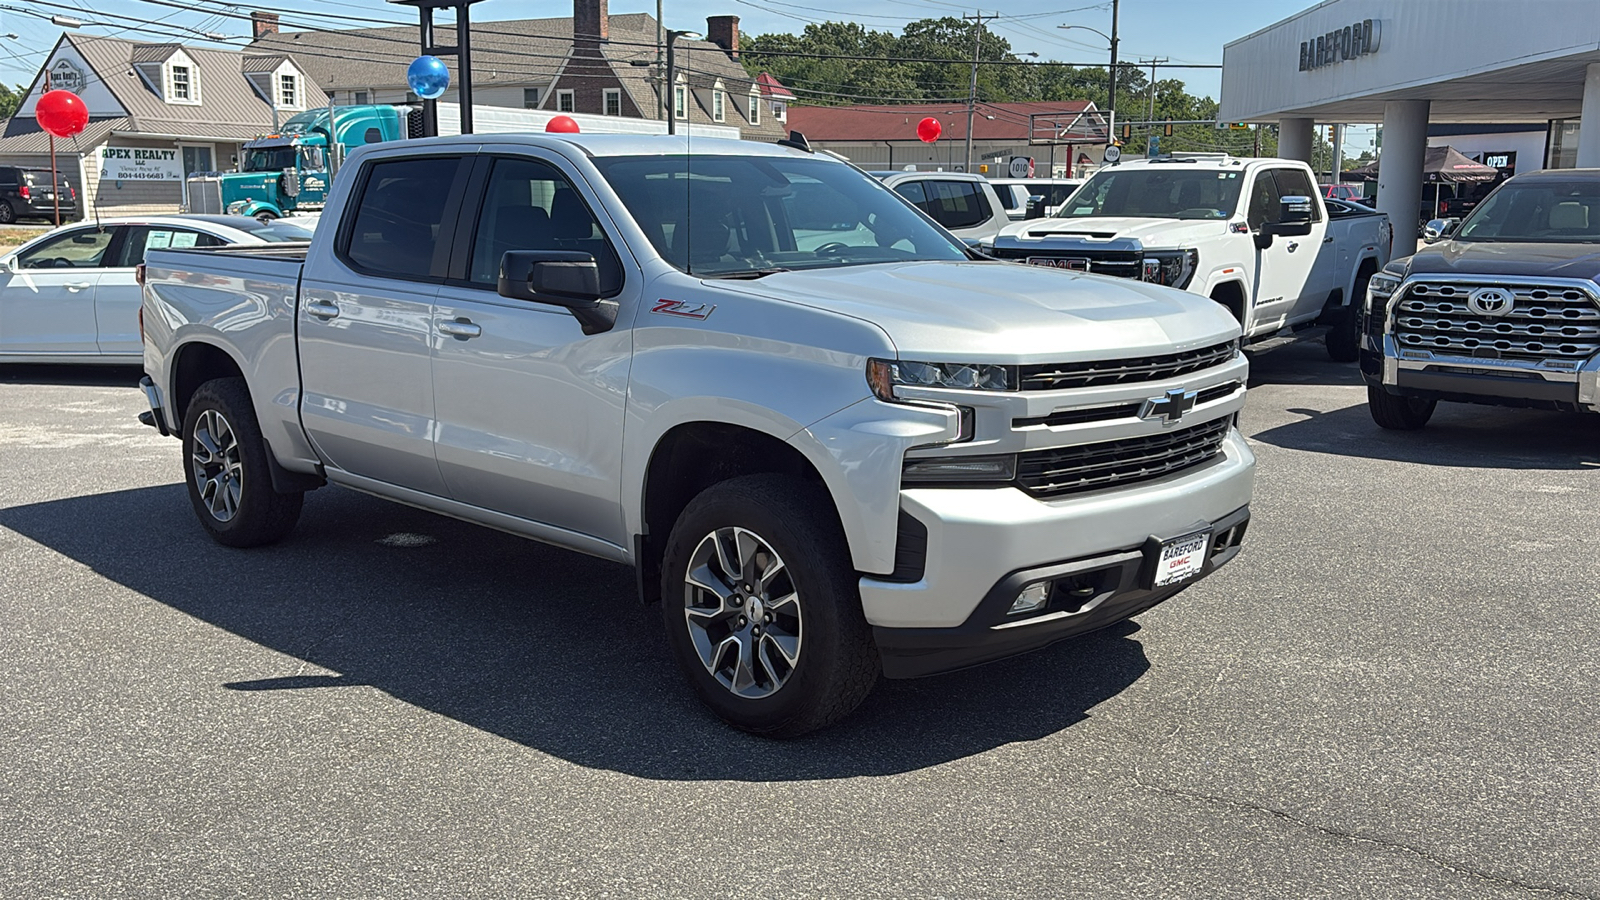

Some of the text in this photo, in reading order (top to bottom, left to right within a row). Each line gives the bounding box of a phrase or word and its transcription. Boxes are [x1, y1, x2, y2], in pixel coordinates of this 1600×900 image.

[1299, 19, 1376, 72] BAREFORD
[102, 149, 175, 161] APEX REALTY
[1487, 155, 1508, 168] OPEN
[1012, 163, 1028, 172] 1010
[650, 298, 718, 321] Z71
[1163, 540, 1203, 561] BAREFORD
[1170, 556, 1190, 568] GMC
